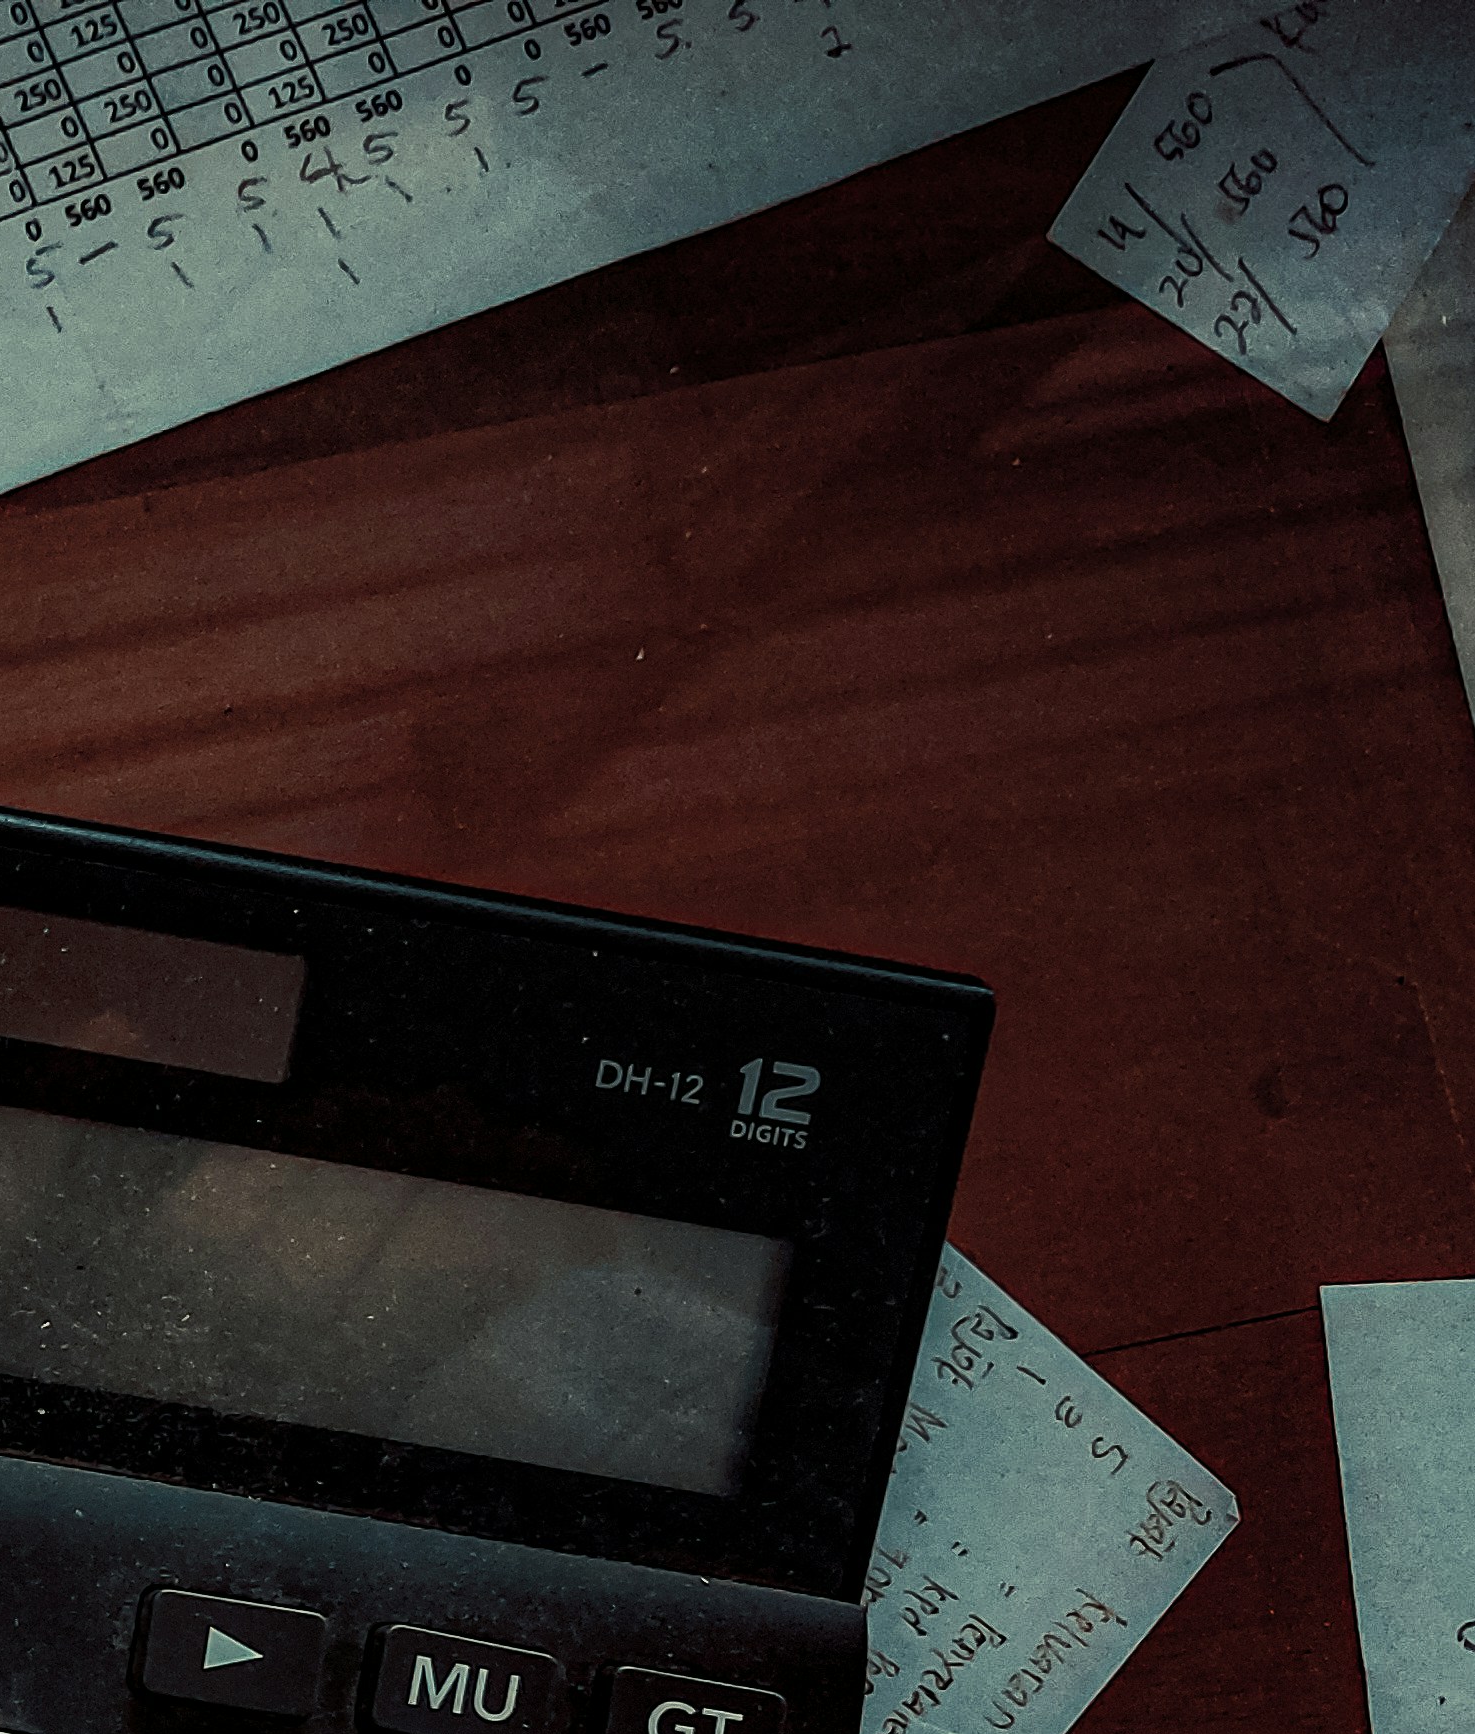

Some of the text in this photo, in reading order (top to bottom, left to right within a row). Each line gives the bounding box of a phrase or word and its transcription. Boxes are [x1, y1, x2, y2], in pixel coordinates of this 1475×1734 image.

[596, 1060, 703, 1104] DH-12
[738, 1058, 820, 1125] 12
[731, 1120, 807, 1149] DIGITS
[408, 1652, 522, 1723] MU
